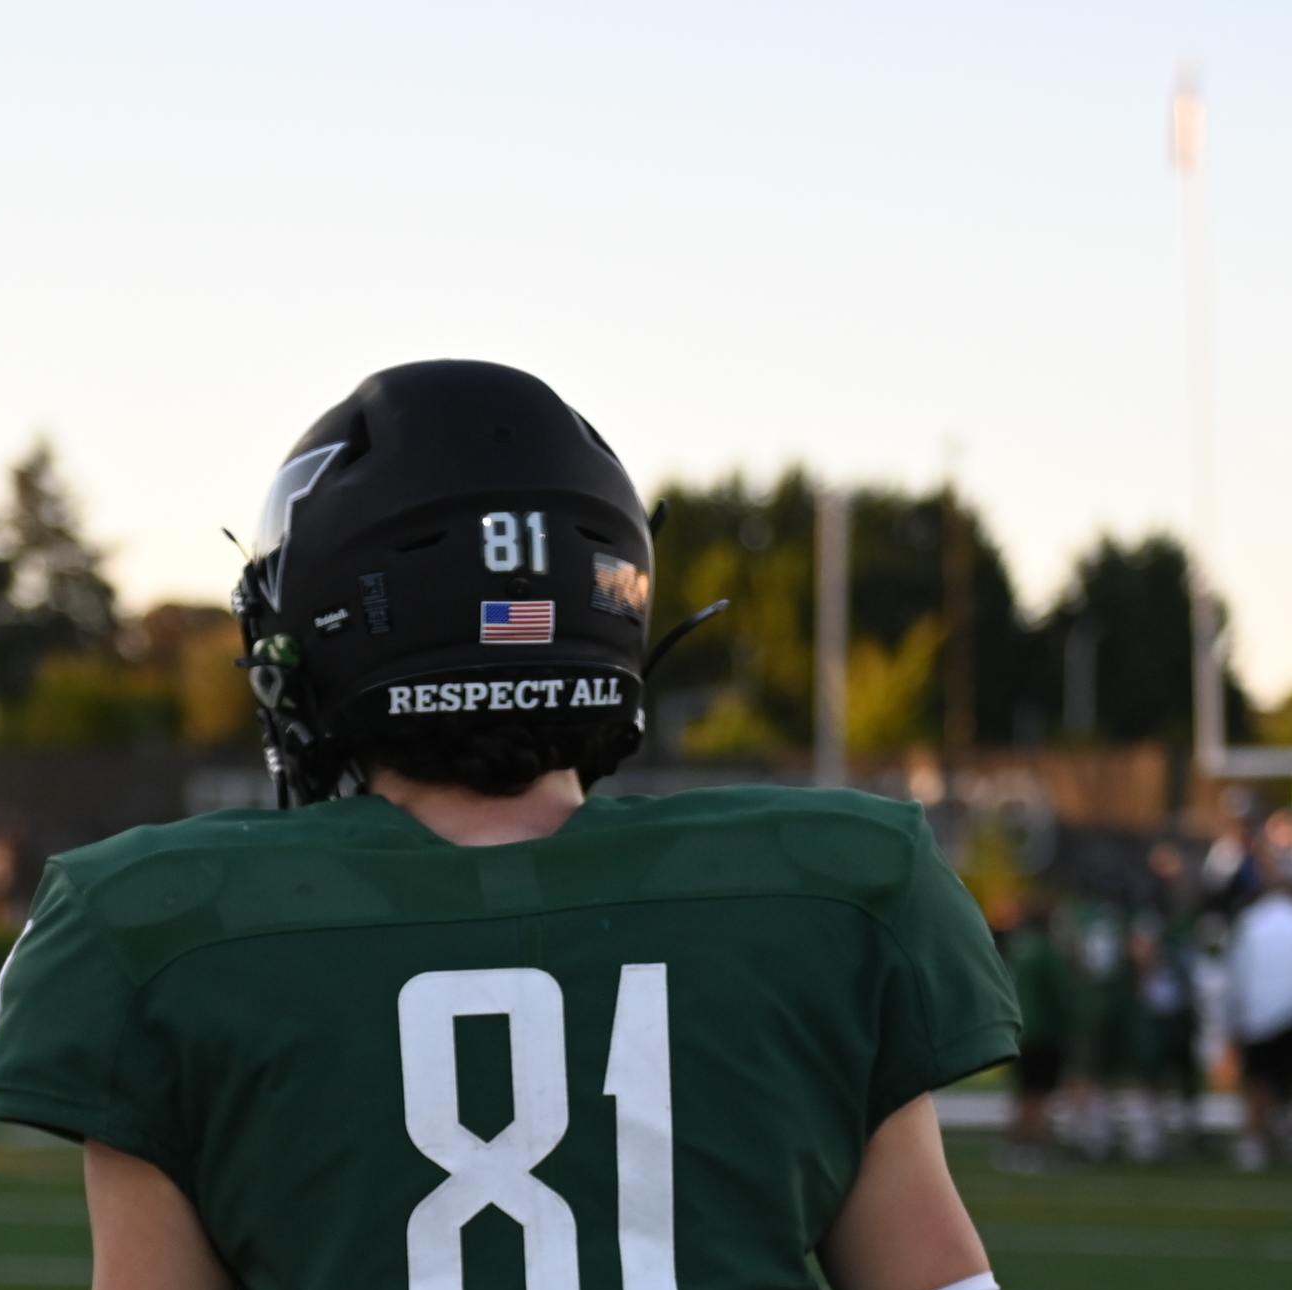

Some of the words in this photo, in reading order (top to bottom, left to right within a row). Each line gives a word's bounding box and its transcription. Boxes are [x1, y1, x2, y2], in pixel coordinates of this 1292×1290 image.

[482, 510, 548, 574] 81
[388, 679, 564, 715] RESPECT
[569, 677, 622, 707] ALL
